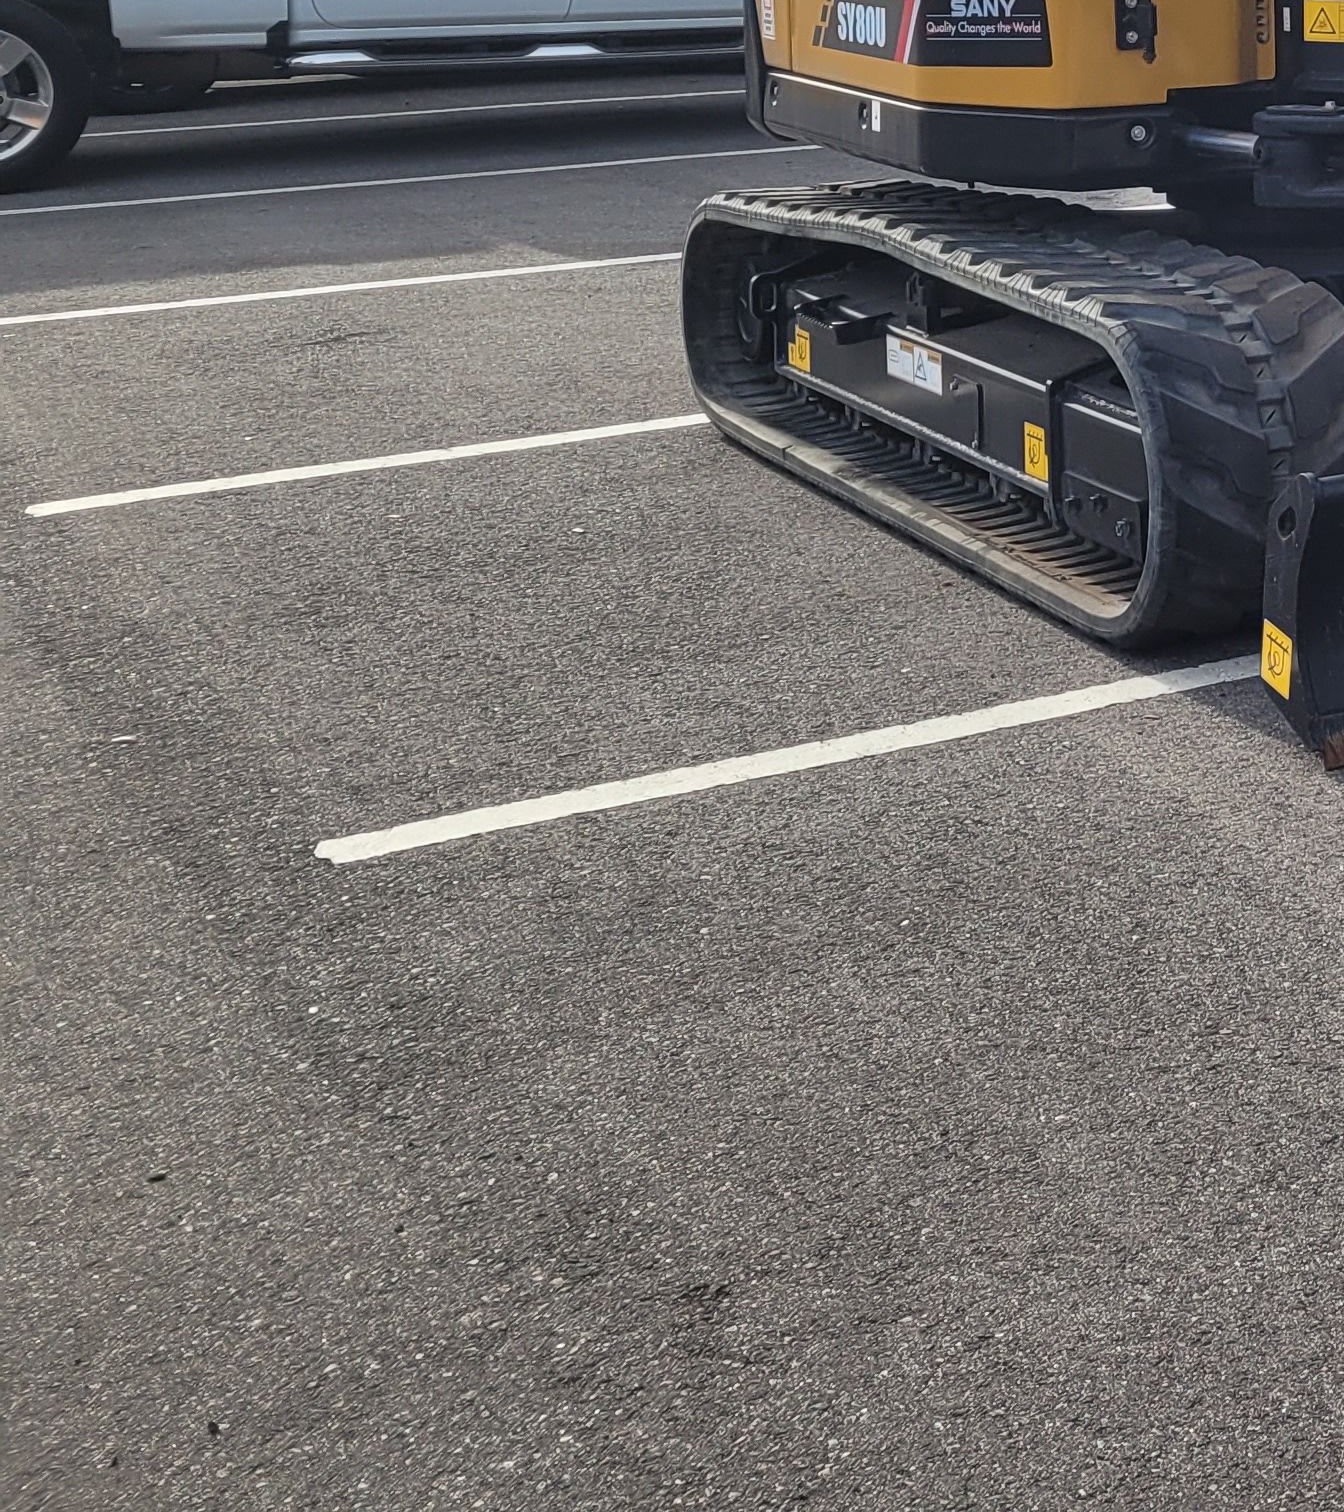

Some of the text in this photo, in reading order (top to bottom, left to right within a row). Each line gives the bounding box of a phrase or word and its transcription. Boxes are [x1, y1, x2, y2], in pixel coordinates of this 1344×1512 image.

[837, 1, 886, 48] SY80U
[926, 19, 1042, 37] Quality Changes the World
